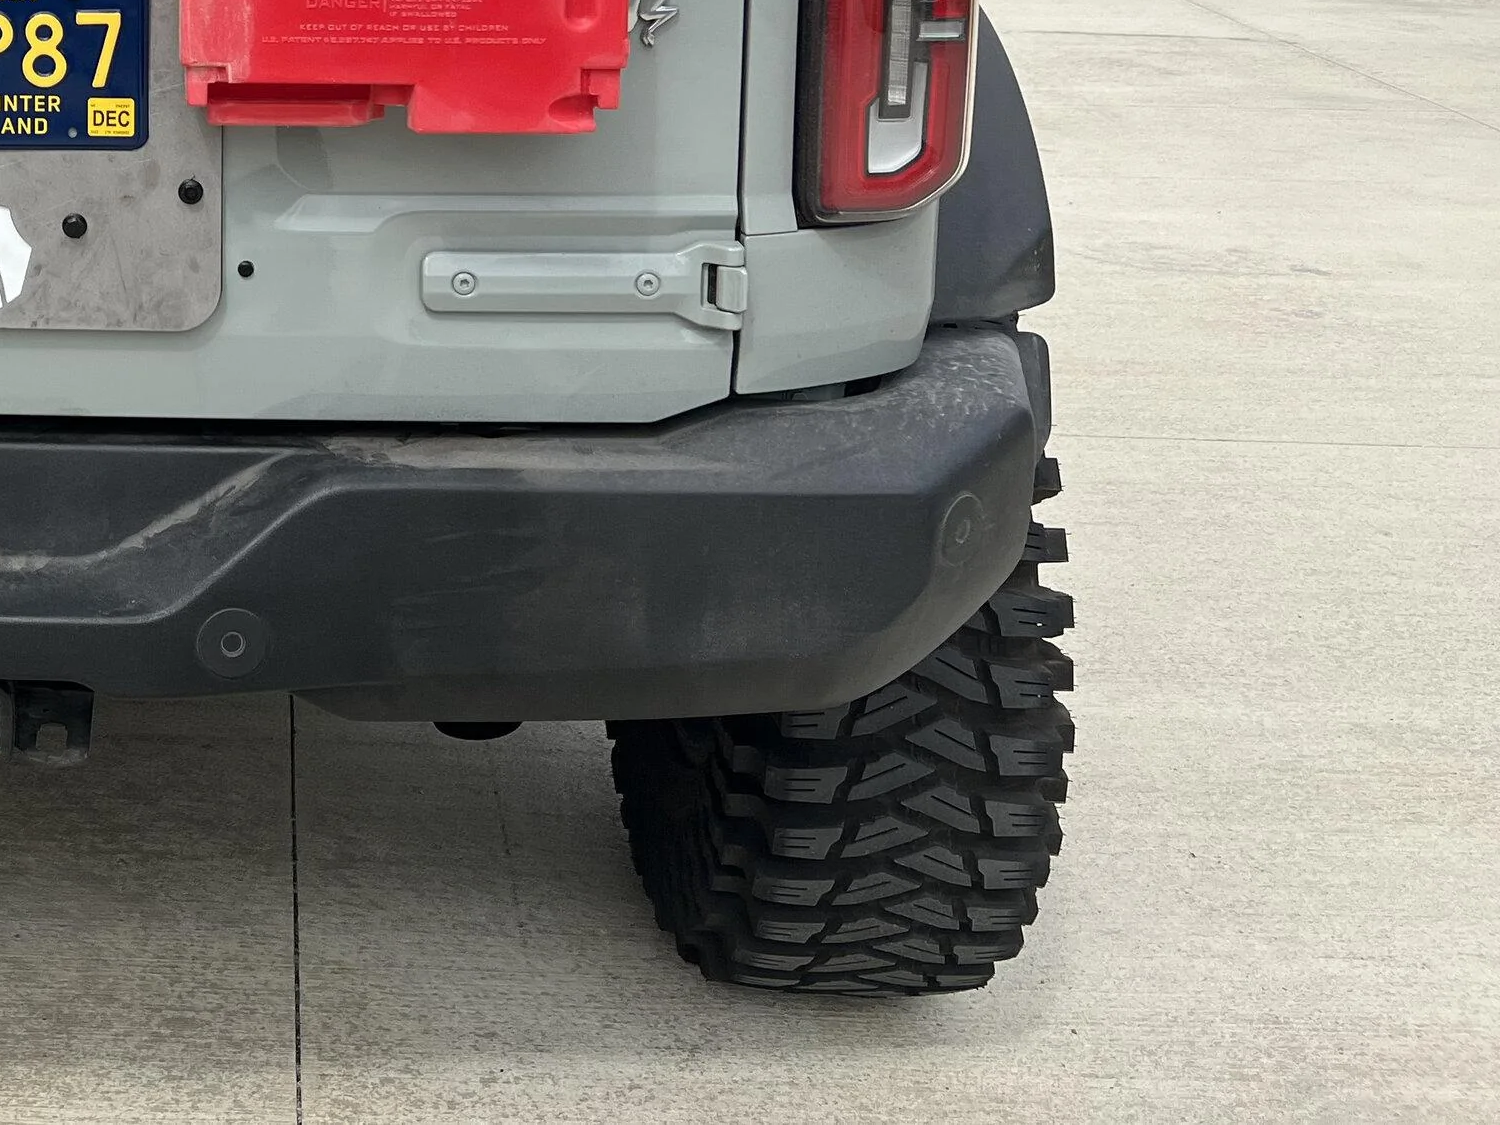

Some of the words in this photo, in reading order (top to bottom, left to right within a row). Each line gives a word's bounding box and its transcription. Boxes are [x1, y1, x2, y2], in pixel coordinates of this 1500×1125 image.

[458, 24, 509, 32] CHILDREN
[281, 36, 322, 44] PATENT
[93, 110, 130, 127] DEC
